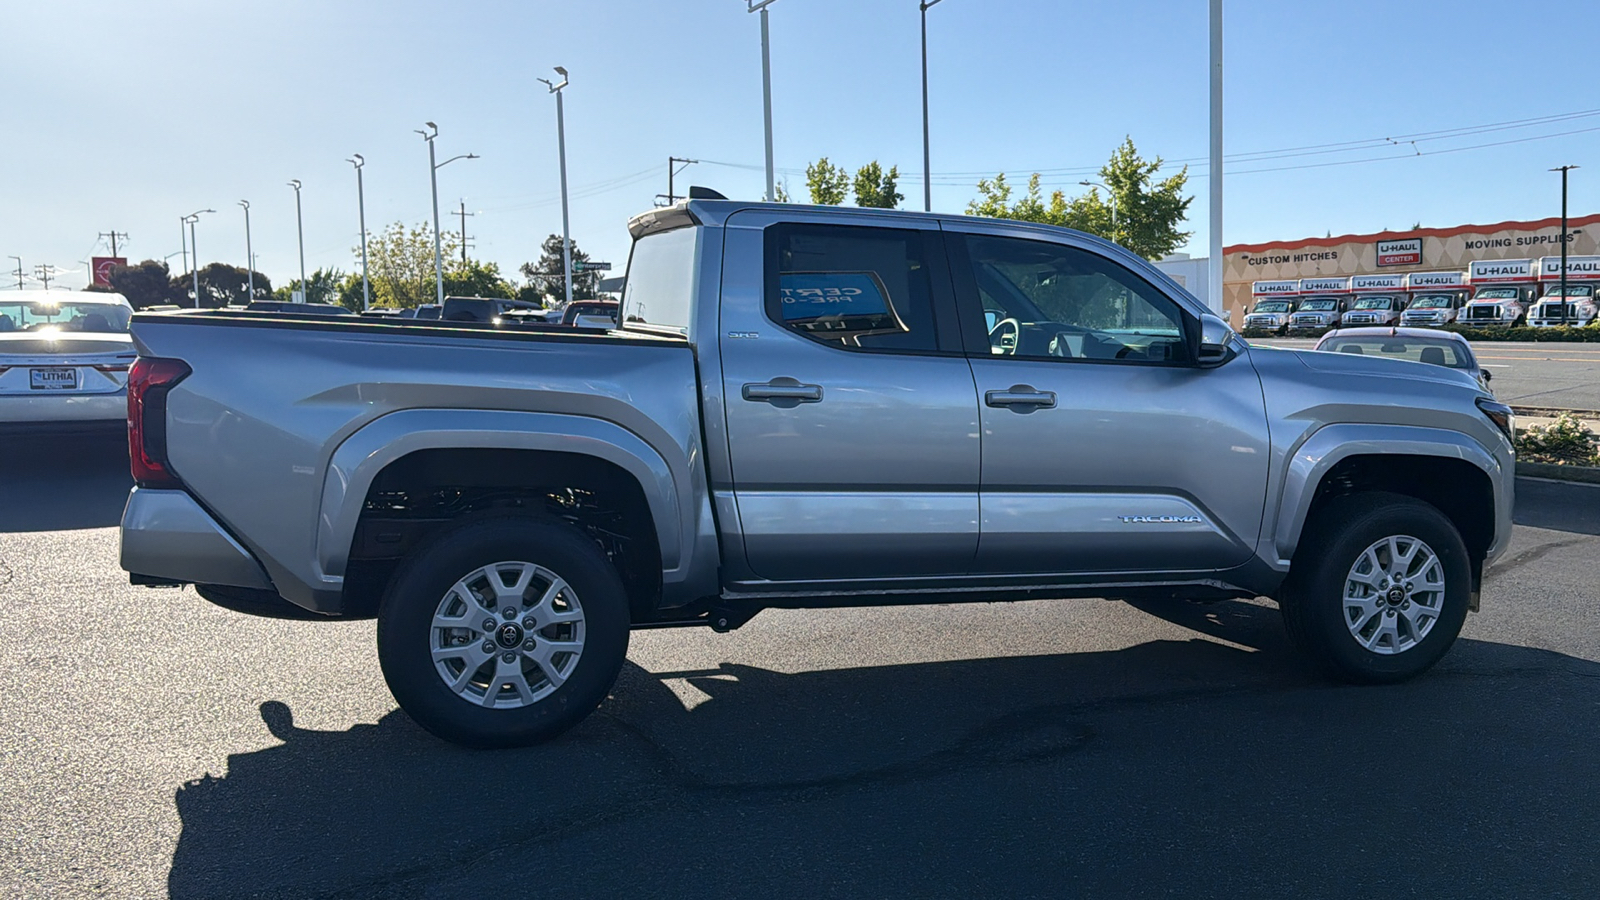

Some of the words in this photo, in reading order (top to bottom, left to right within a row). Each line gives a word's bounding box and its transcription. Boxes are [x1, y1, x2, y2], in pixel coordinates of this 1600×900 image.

[1380, 243, 1418, 253] U-HAUL
[1465, 238, 1512, 250] MOVING
[1248, 255, 1290, 266] CUSTOM
[1294, 251, 1338, 263] HITCHES
[1384, 255, 1414, 263] CENTER
[1476, 266, 1527, 275] U-HAUL
[1357, 280, 1396, 288] U-HAUL
[1414, 277, 1455, 285] U-HAUL
[1305, 282, 1342, 290] U-HAUL
[42, 372, 74, 381] LITHIA
[1117, 515, 1202, 523] TACOMA
